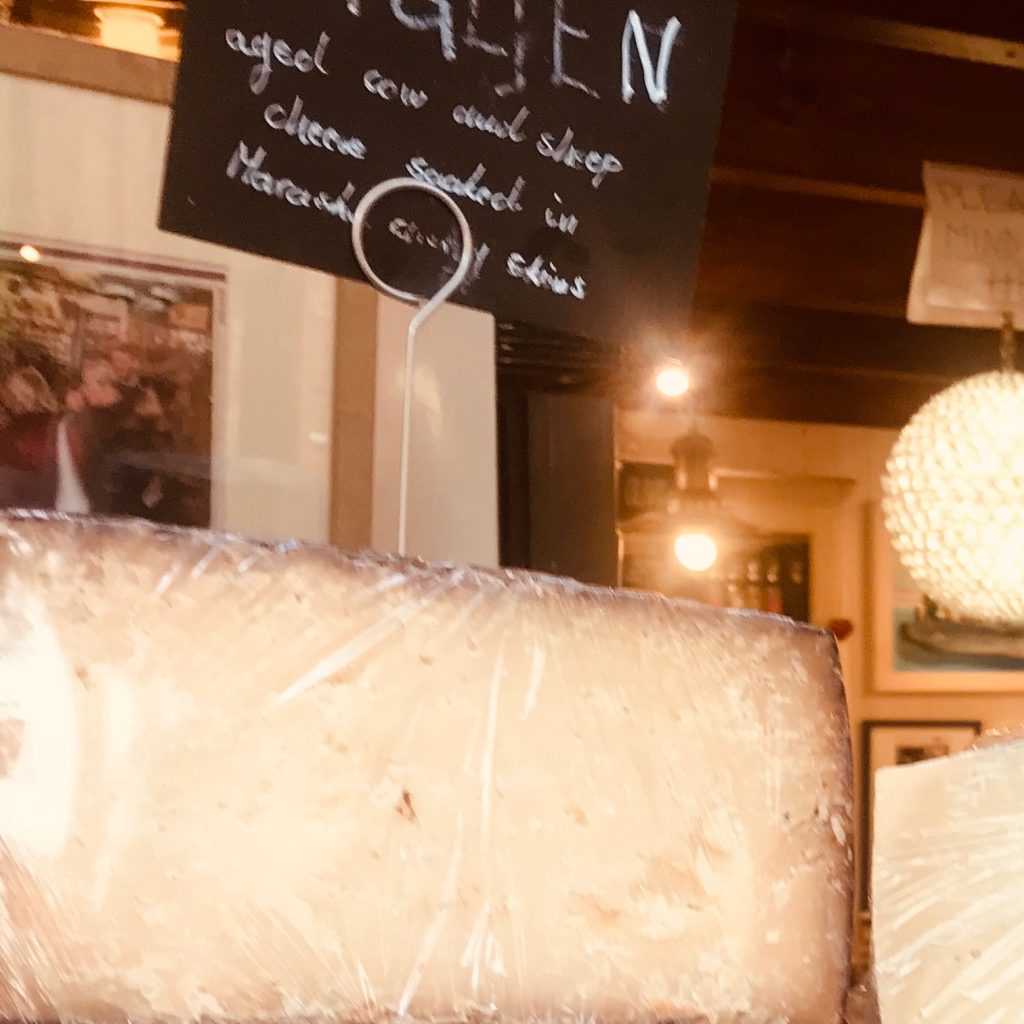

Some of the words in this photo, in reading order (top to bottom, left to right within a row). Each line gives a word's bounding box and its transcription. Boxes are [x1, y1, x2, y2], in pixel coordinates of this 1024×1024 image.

[225, 28, 331, 95] aged
[363, 69, 428, 109] cow
[452, 105, 531, 143] and
[536, 126, 624, 190] sheep
[264, 94, 367, 160] cheese
[545, 191, 579, 236] in
